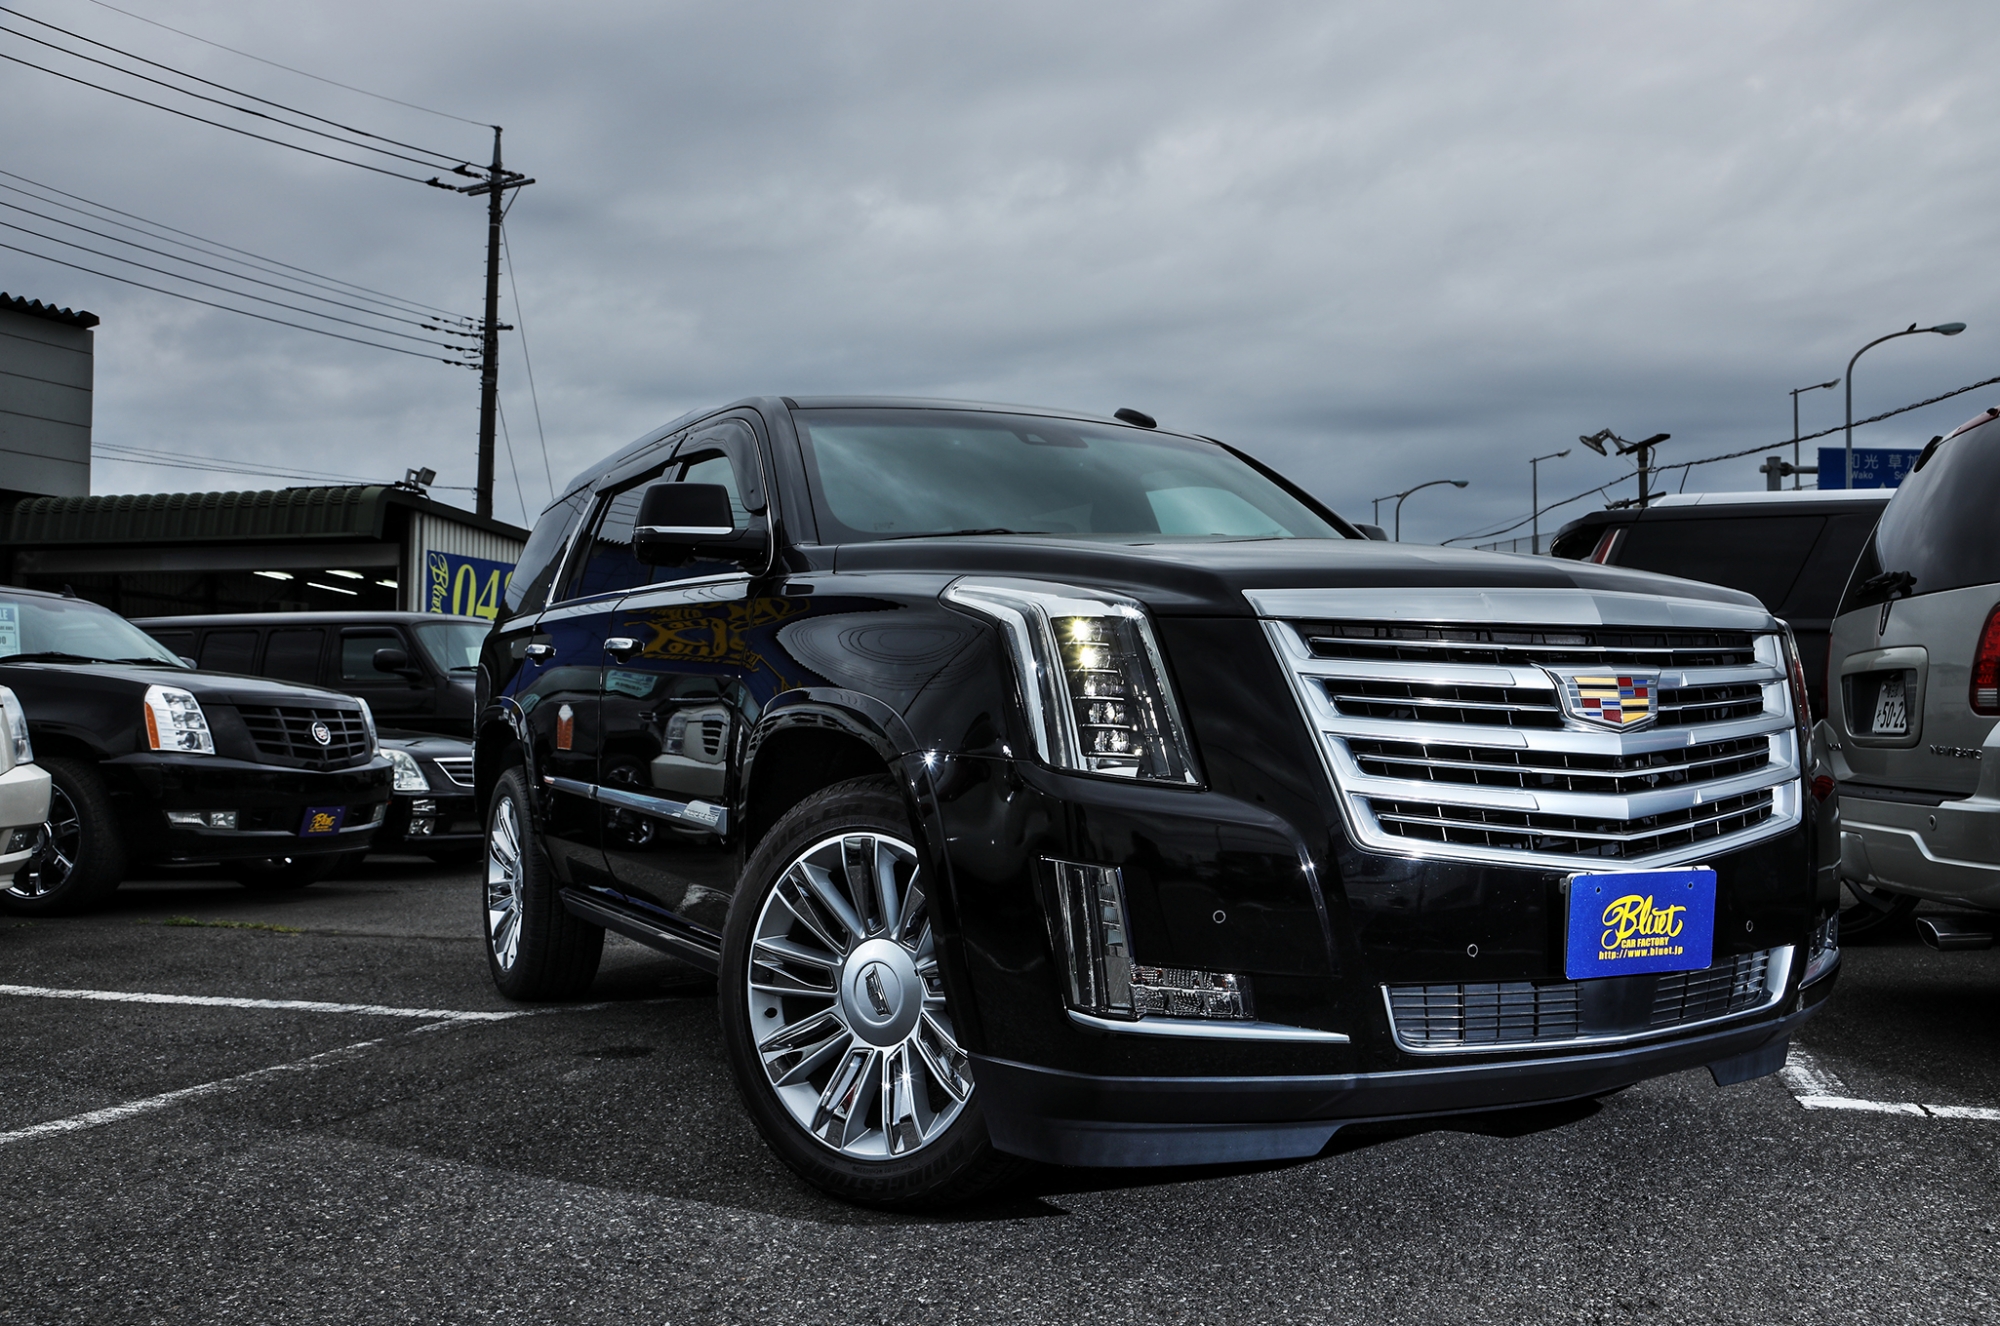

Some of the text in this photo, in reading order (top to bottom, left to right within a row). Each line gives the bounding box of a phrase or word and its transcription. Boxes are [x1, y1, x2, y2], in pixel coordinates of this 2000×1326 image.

[1601, 894, 1687, 950] Bluet
[1621, 936, 1670, 949] CAR FACTORY
[1598, 946, 1684, 960] http://www.bluet.jp
